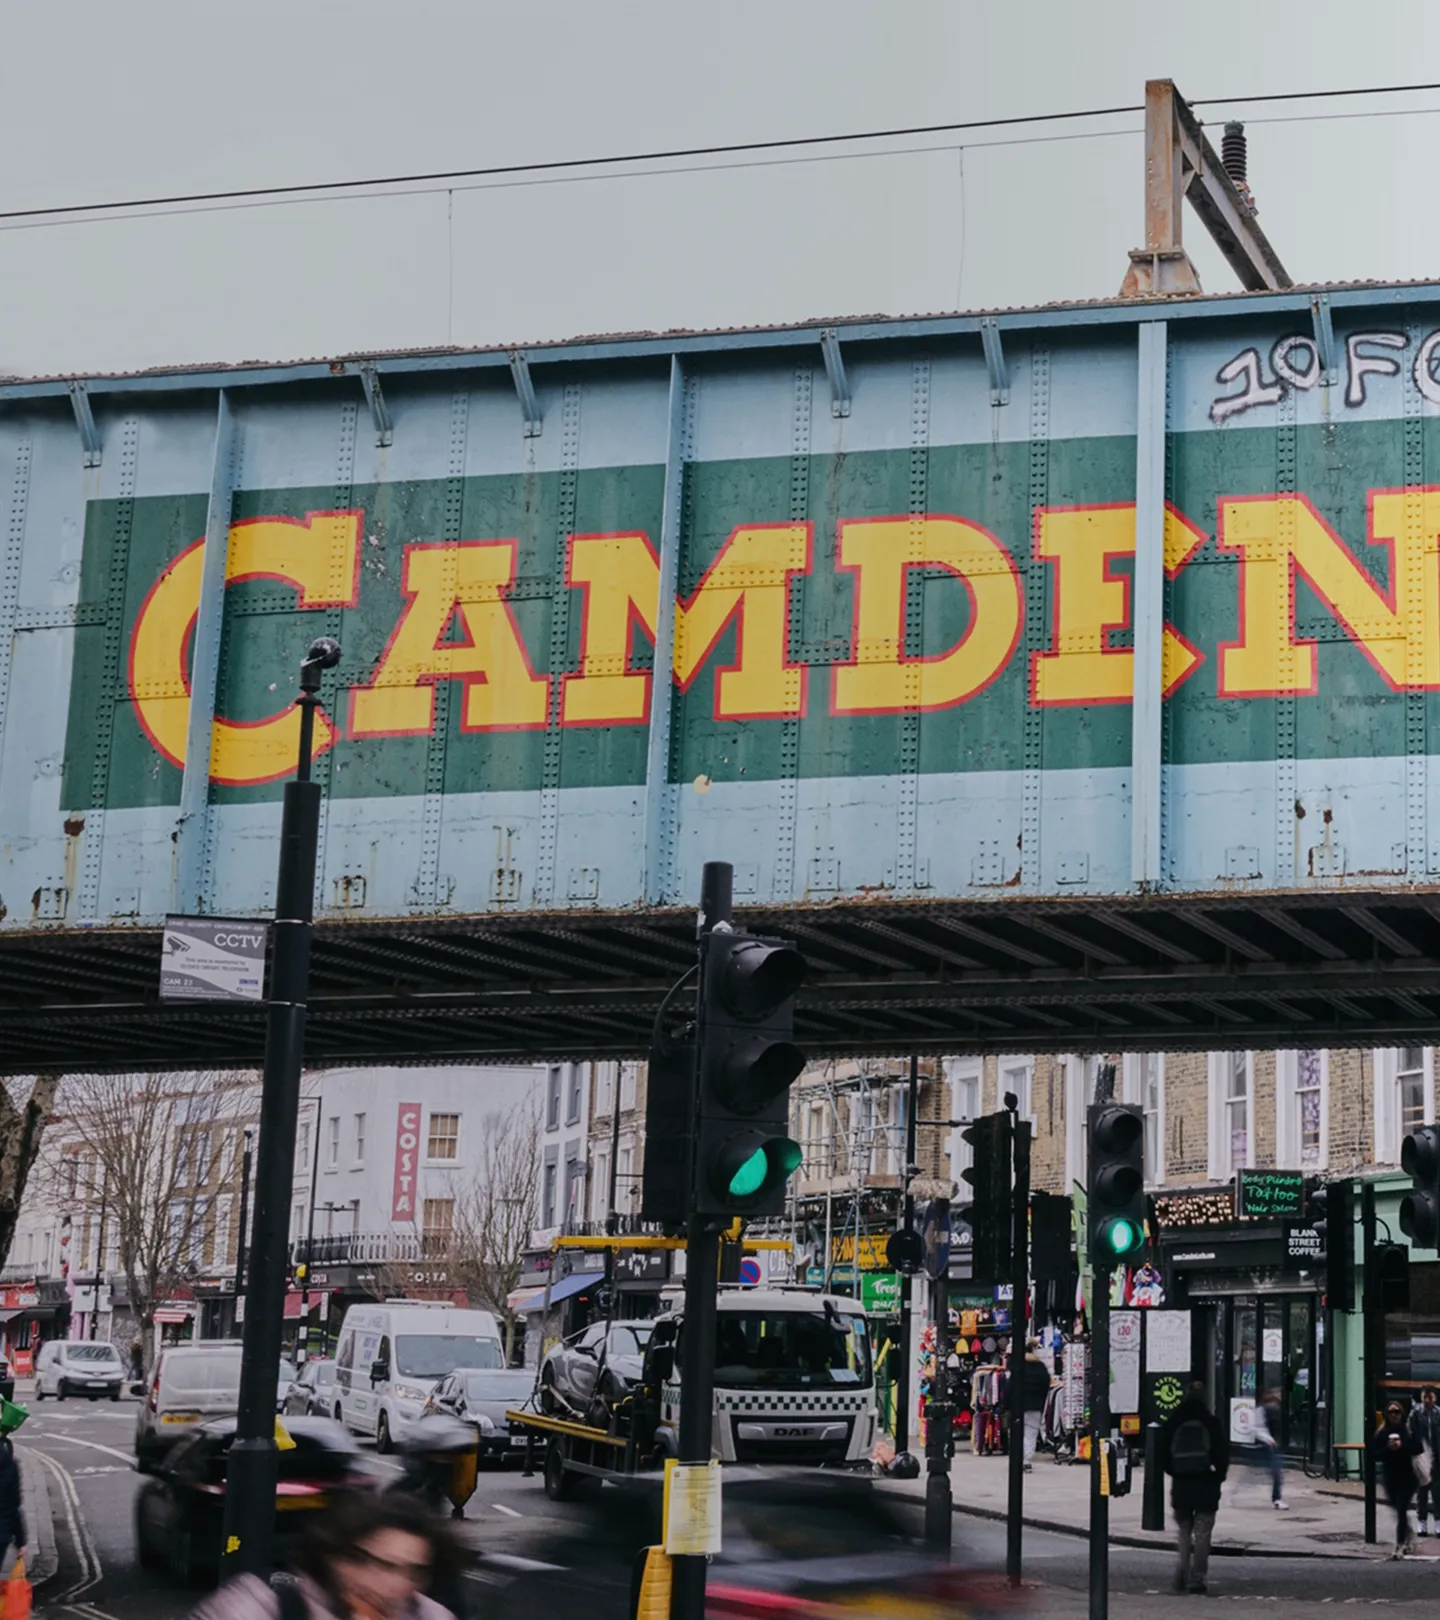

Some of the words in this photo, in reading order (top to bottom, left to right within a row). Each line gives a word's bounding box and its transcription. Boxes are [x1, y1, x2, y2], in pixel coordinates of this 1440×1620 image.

[214, 933, 262, 949] CCTV
[395, 1112, 417, 1212] COSTA
[1246, 1186, 1298, 1201] Tattoo
[1290, 1229, 1319, 1237] BLANK
[1288, 1238, 1321, 1246] STREET
[1288, 1247, 1321, 1256] COFFEE
[774, 1428, 815, 1437] DAF
